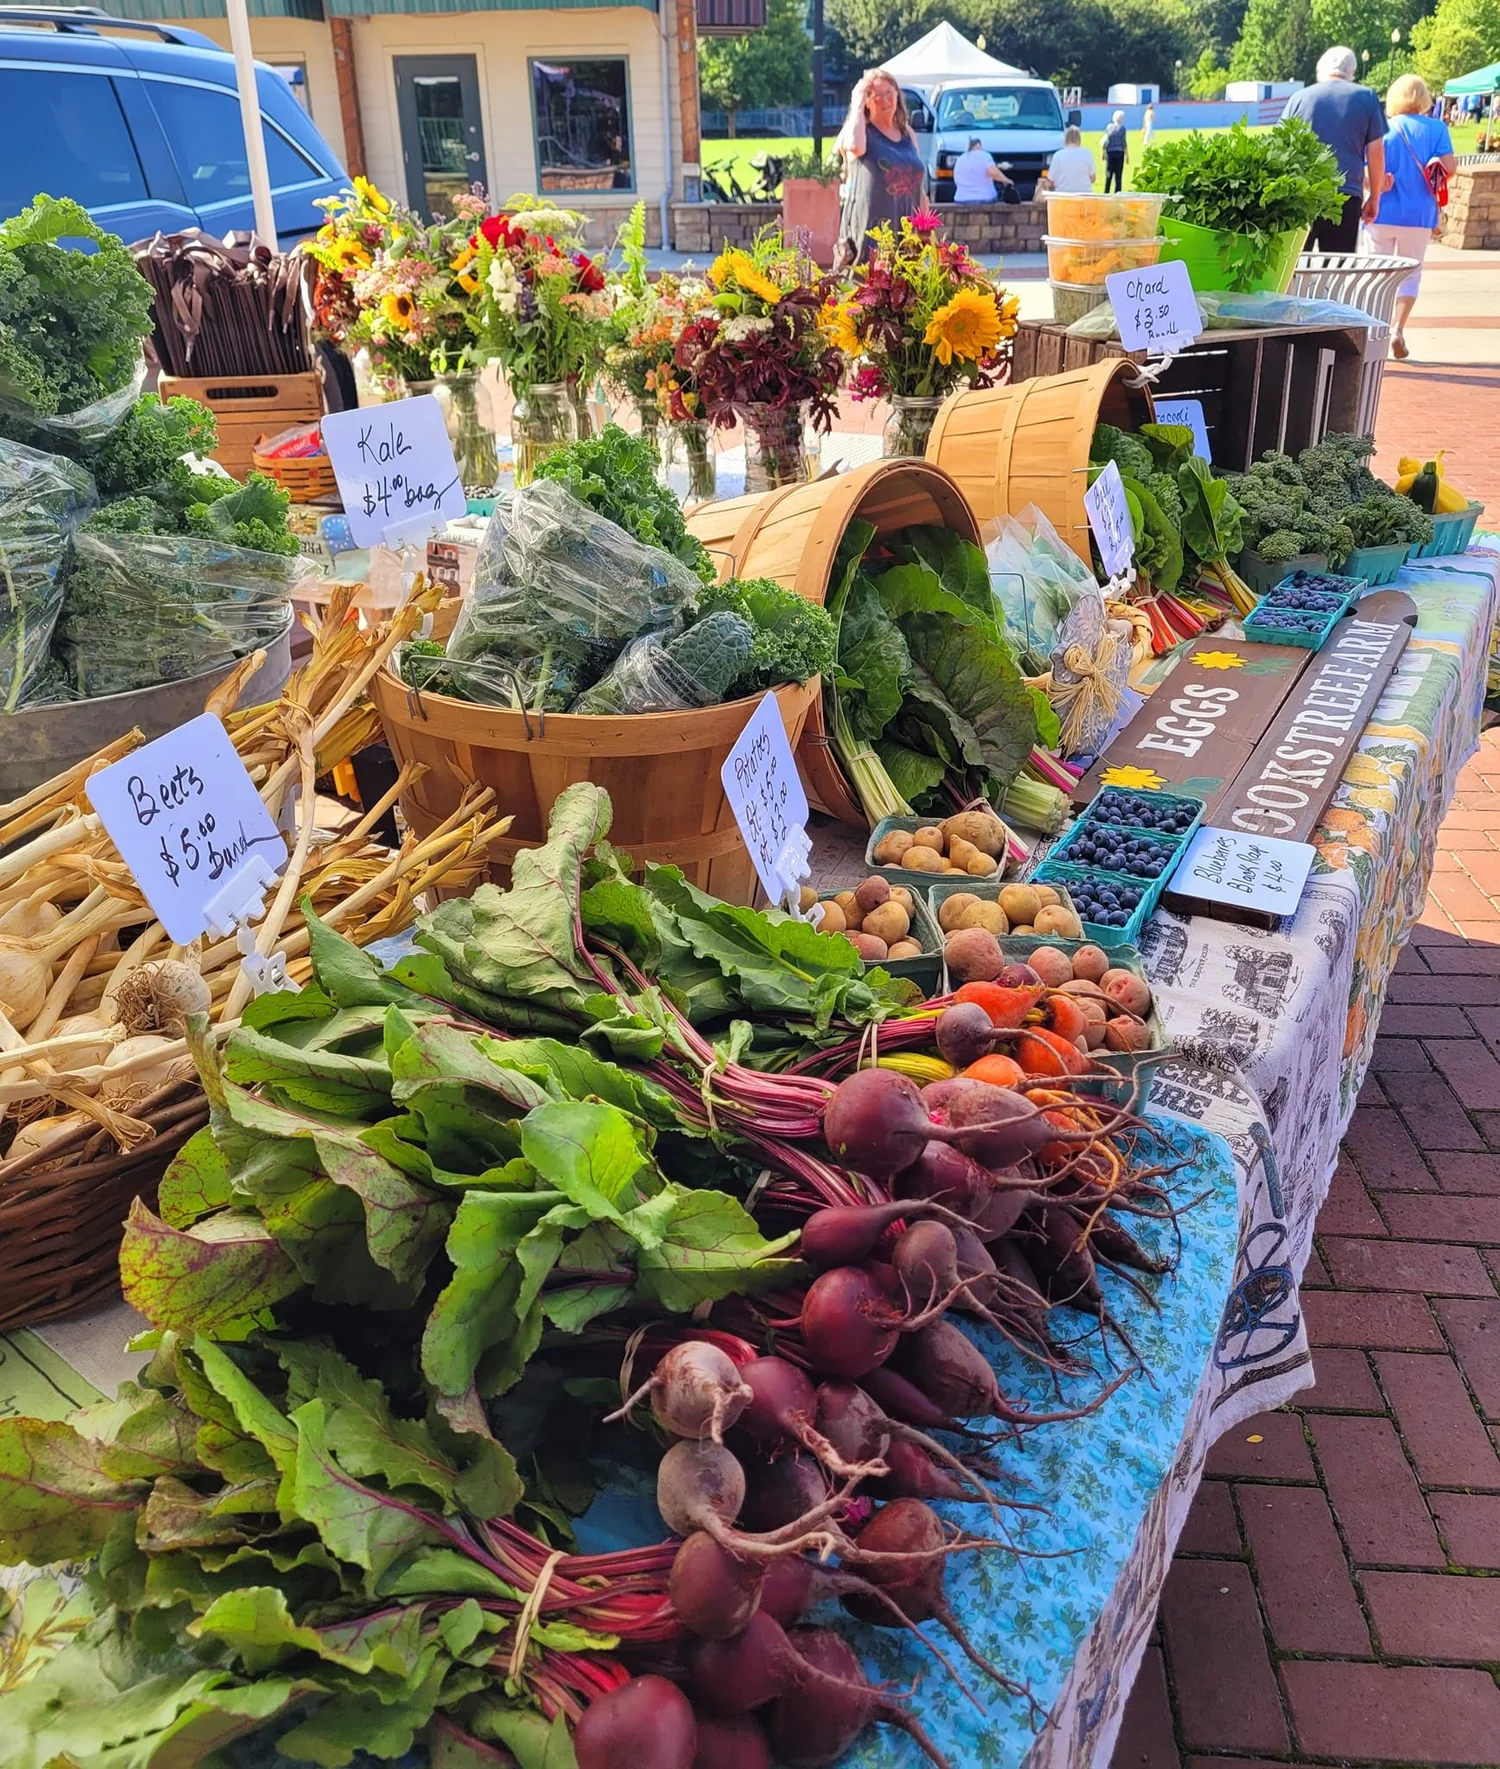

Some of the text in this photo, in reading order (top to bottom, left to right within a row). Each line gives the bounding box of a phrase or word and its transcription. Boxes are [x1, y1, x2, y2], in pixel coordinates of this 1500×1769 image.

[1126, 275, 1169, 301] Chard
[357, 422, 412, 466] Kale
[404, 475, 459, 511] bag
[1136, 684, 1240, 758] EGGS
[1231, 618, 1401, 835] OOKSTREEFARM
[127, 764, 204, 826] Beets
